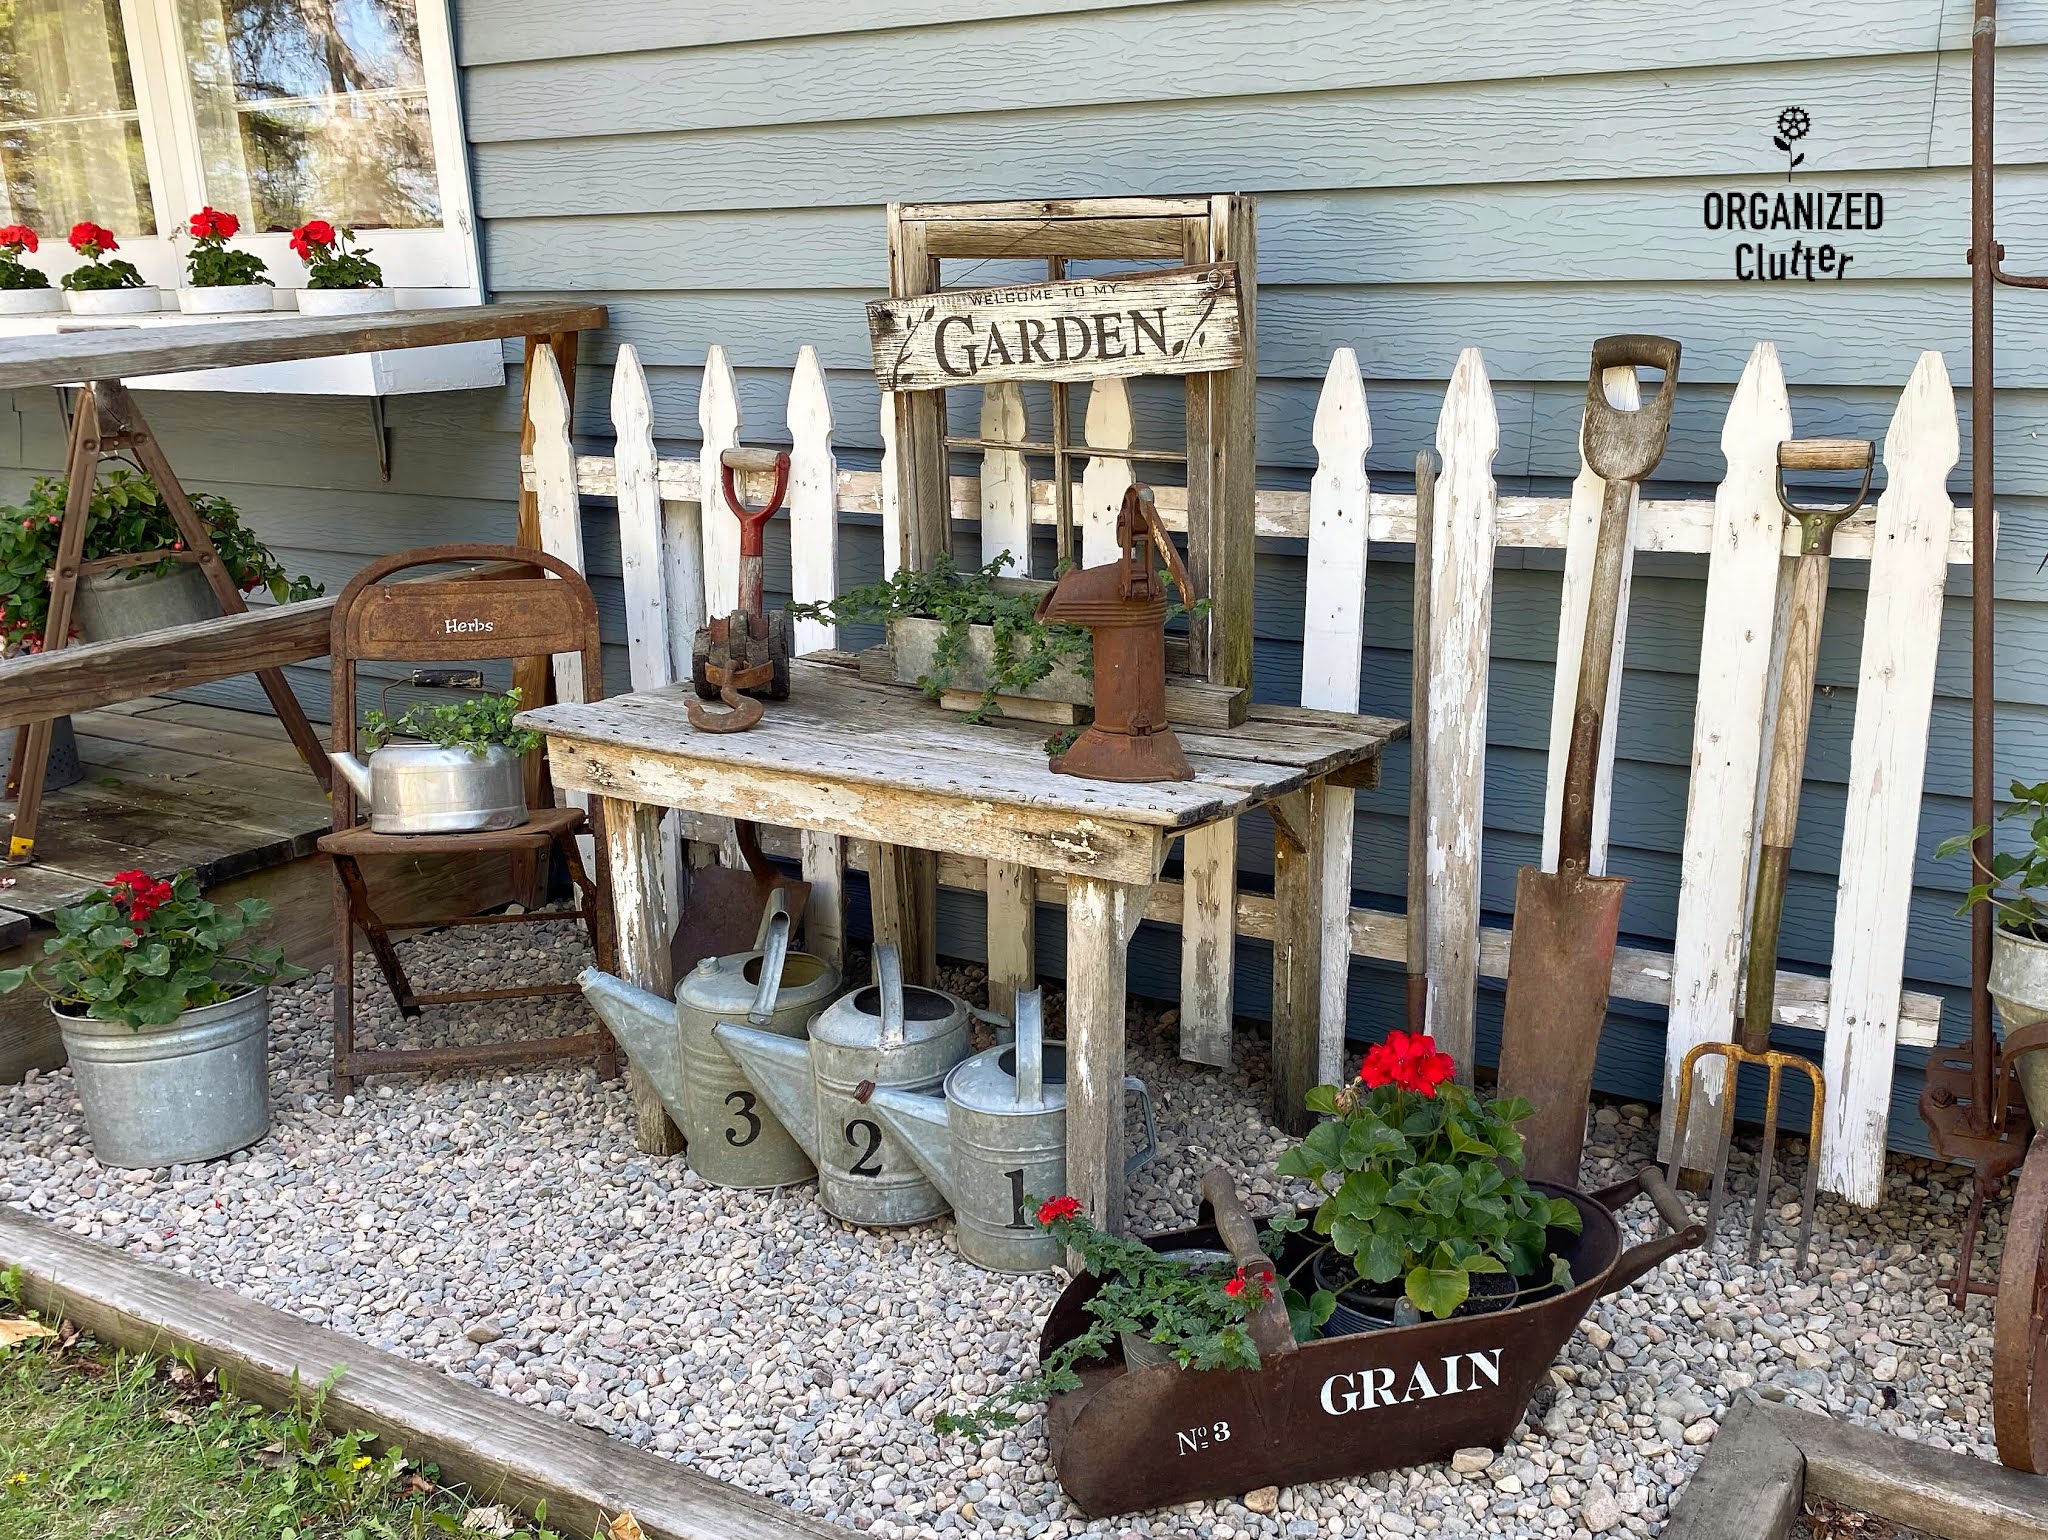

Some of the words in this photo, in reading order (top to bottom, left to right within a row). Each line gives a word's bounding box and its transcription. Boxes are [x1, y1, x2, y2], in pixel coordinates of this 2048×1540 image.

[969, 289, 1054, 306] WELCOME
[1061, 286, 1085, 298] TO
[1094, 283, 1118, 296] MY
[935, 307, 1168, 377] GARDEN
[444, 618, 494, 634] Herbs
[724, 1090, 761, 1147] 3
[845, 1119, 883, 1178] 2
[1004, 1168, 1035, 1230] 1
[1319, 1348, 1504, 1416] GRAIN
[1213, 1421, 1231, 1442] 3
